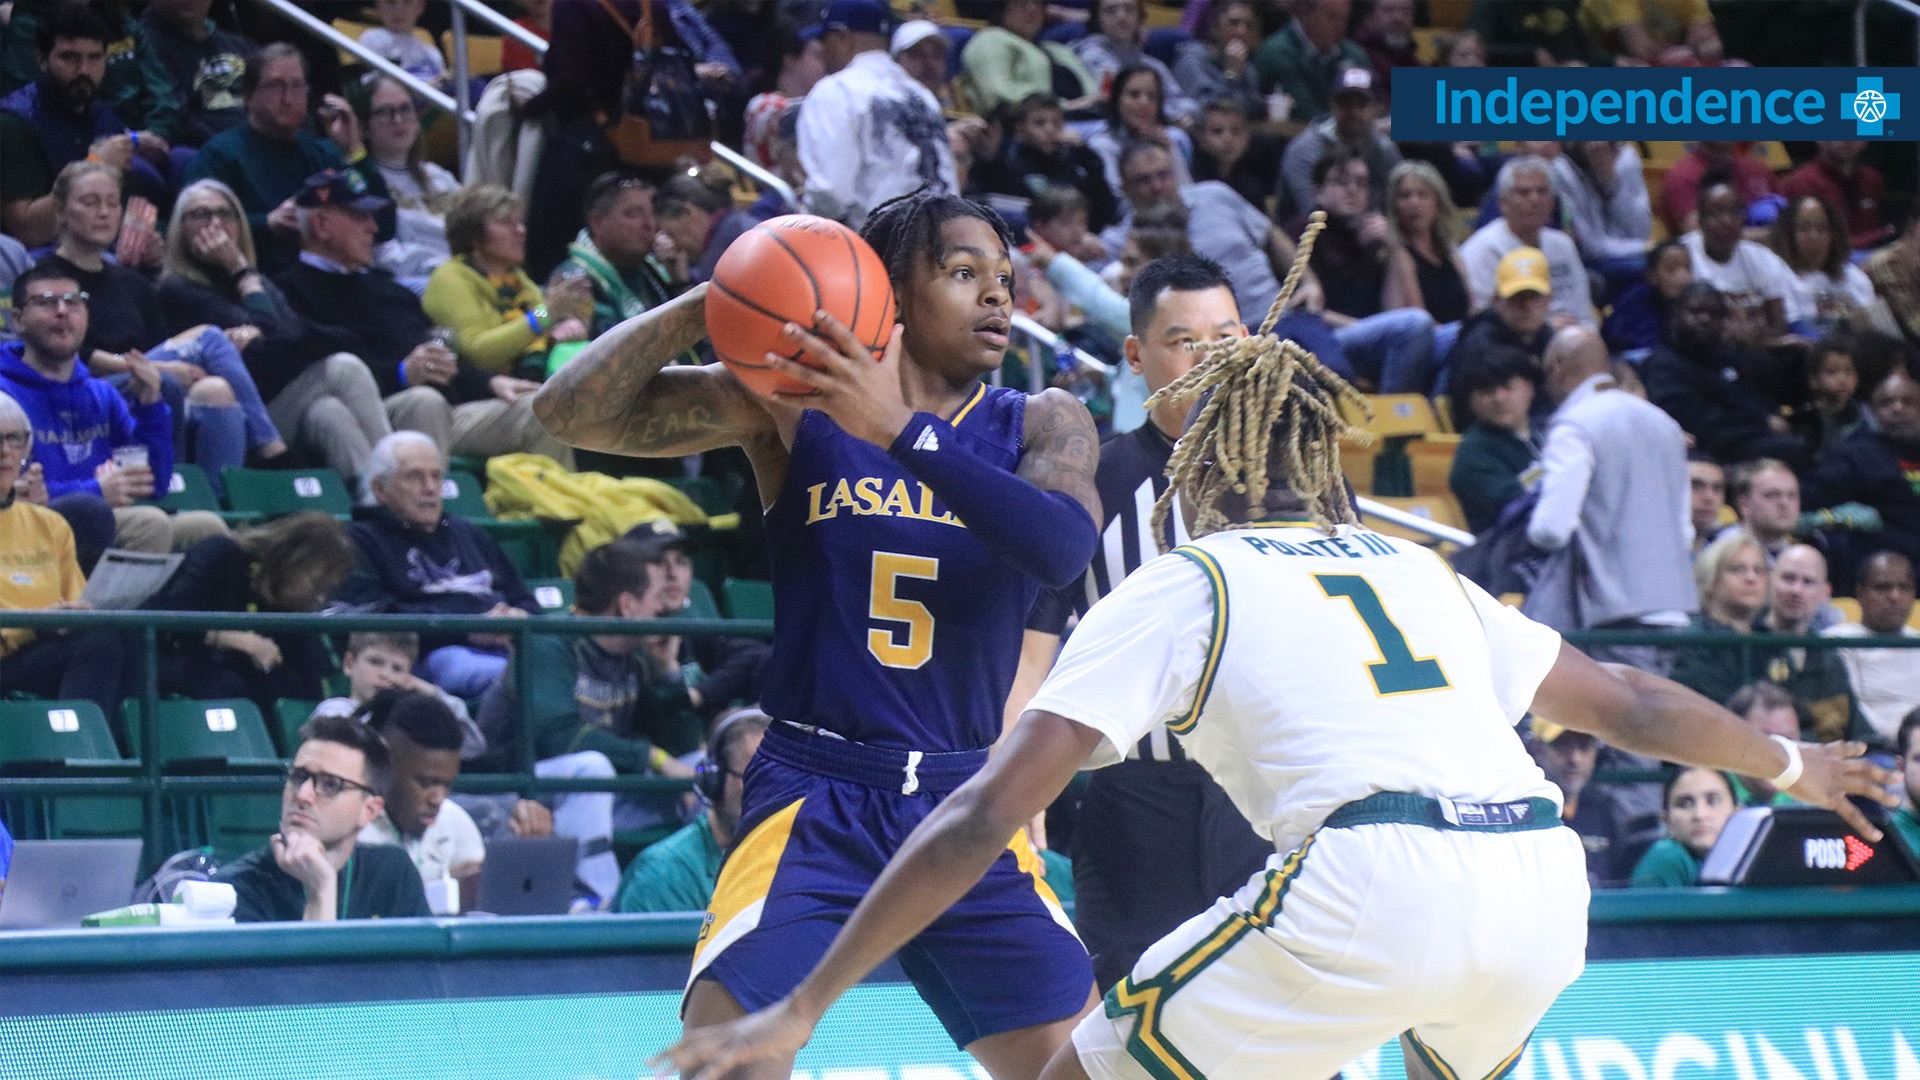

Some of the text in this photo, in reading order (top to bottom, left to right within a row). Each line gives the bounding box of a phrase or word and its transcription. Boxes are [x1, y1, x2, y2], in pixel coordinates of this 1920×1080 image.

[805, 476, 967, 529] LASAL
[1241, 533, 1400, 558] POLITE III
[867, 550, 939, 670] 5
[1310, 572, 1454, 697] 1
[1804, 838, 1847, 869] POSS
[1512, 1027, 1920, 1080] IRGINI
